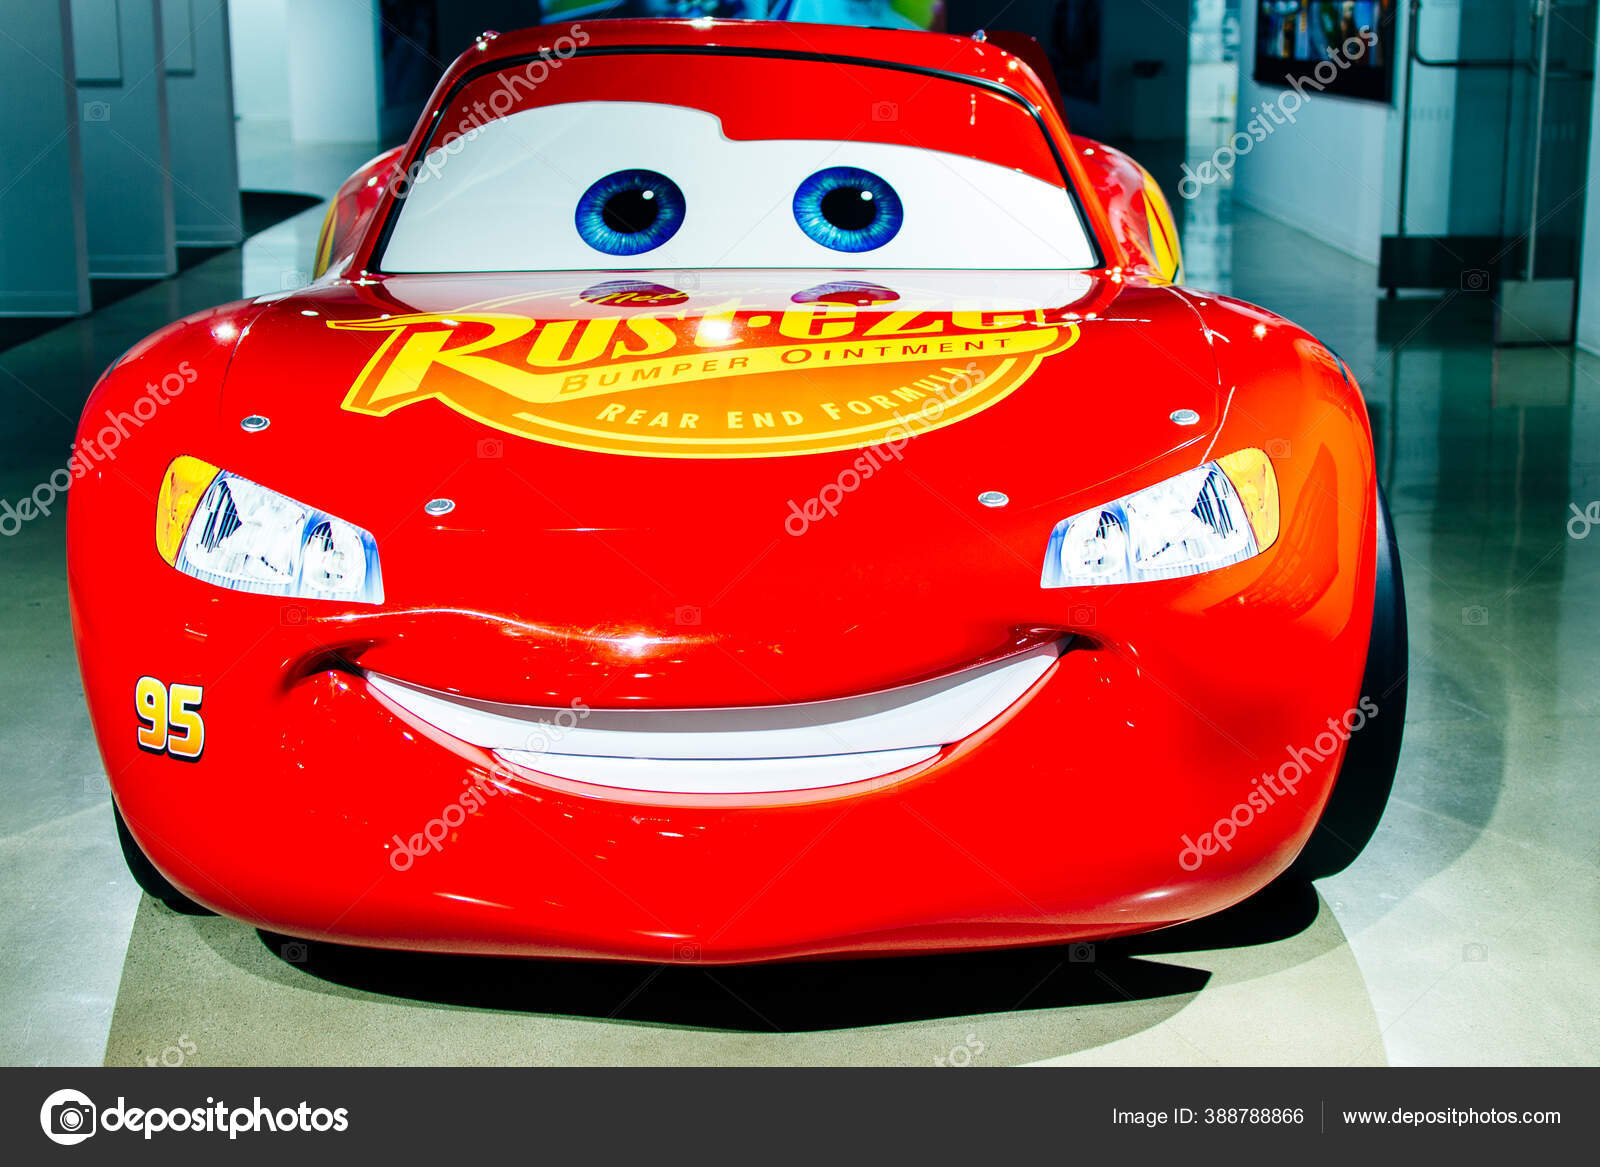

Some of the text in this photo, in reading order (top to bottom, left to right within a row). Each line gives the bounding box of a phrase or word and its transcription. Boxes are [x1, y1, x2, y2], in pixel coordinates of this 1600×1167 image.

[560, 338, 1011, 395] BUMPER OINTMENT
[596, 366, 971, 430] REAR END FORMULA
[134, 675, 205, 763] 95
